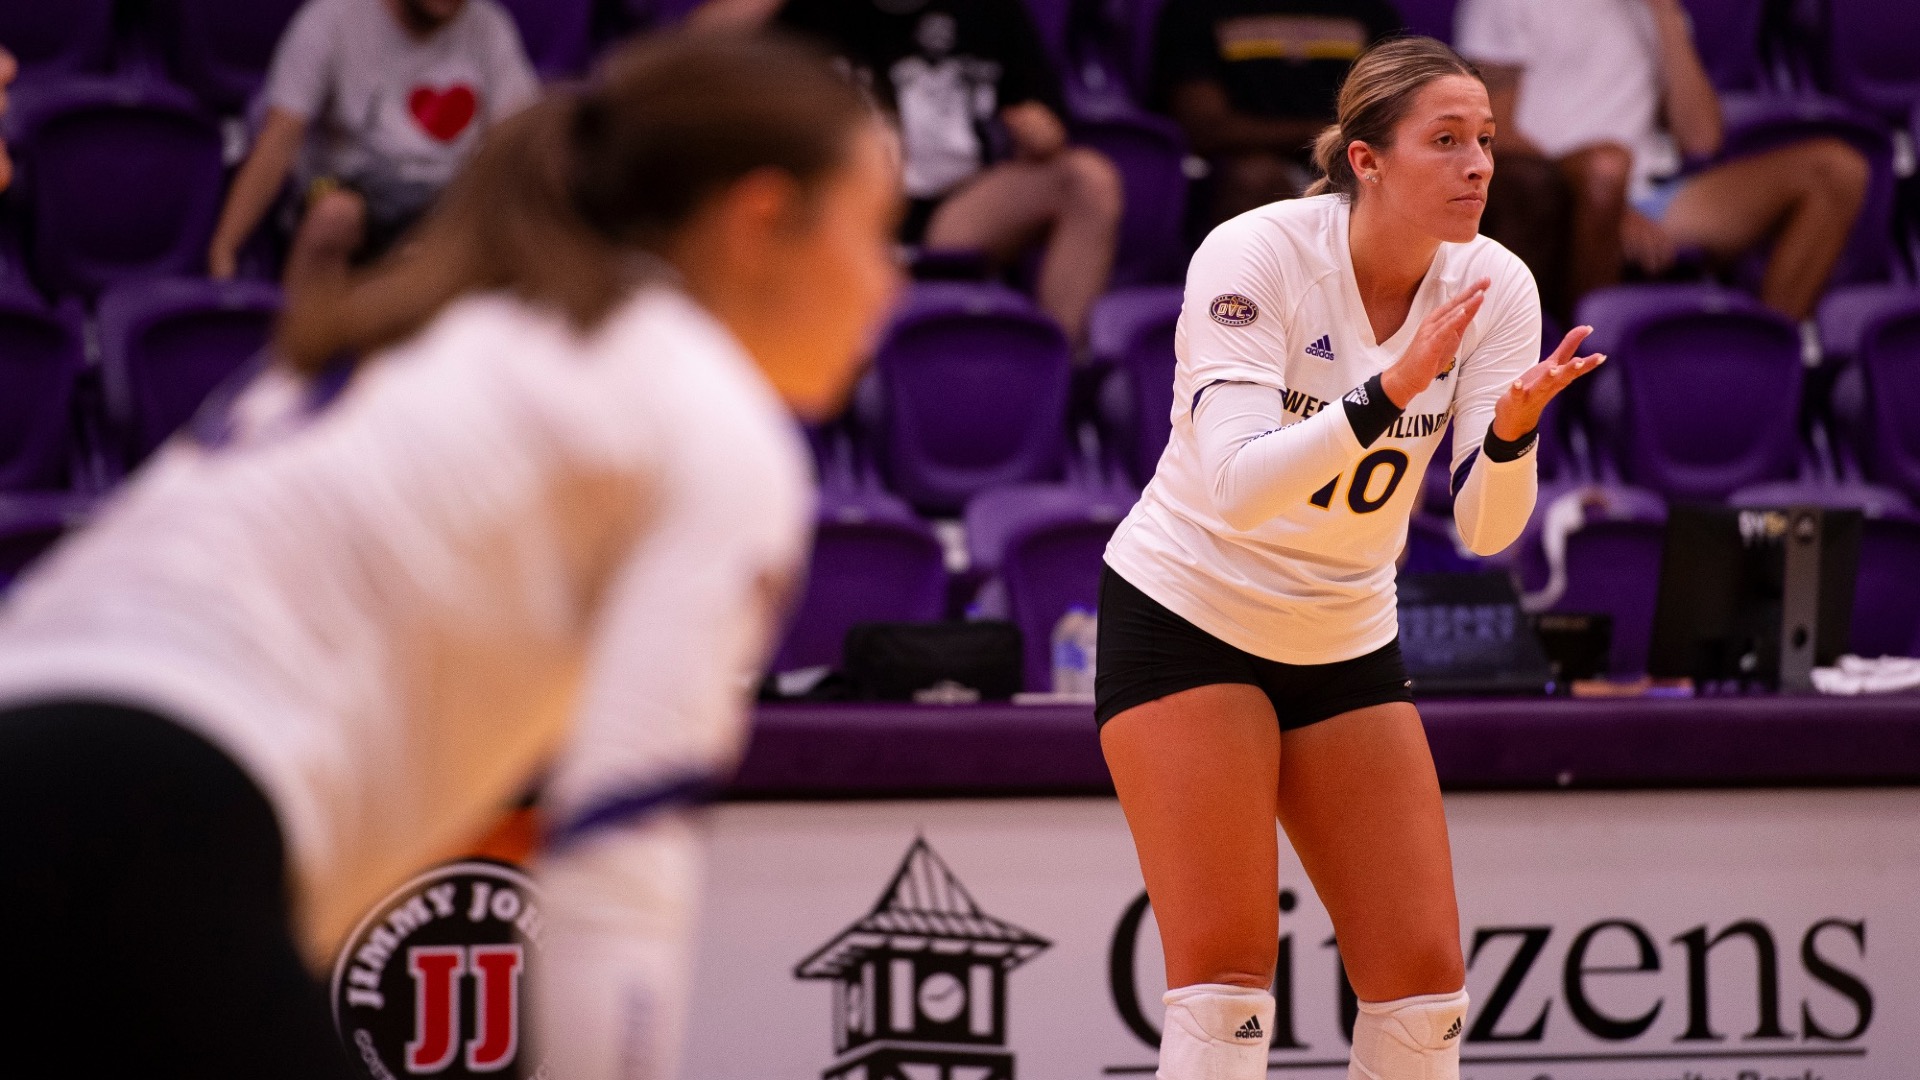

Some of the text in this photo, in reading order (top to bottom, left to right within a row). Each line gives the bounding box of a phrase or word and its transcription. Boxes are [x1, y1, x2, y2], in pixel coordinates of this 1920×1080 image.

[1305, 346, 1335, 361] adidas
[348, 881, 543, 1010] JIMMY JOH
[405, 944, 524, 1074] JJ
[1108, 887, 1875, 1052] Cizens
